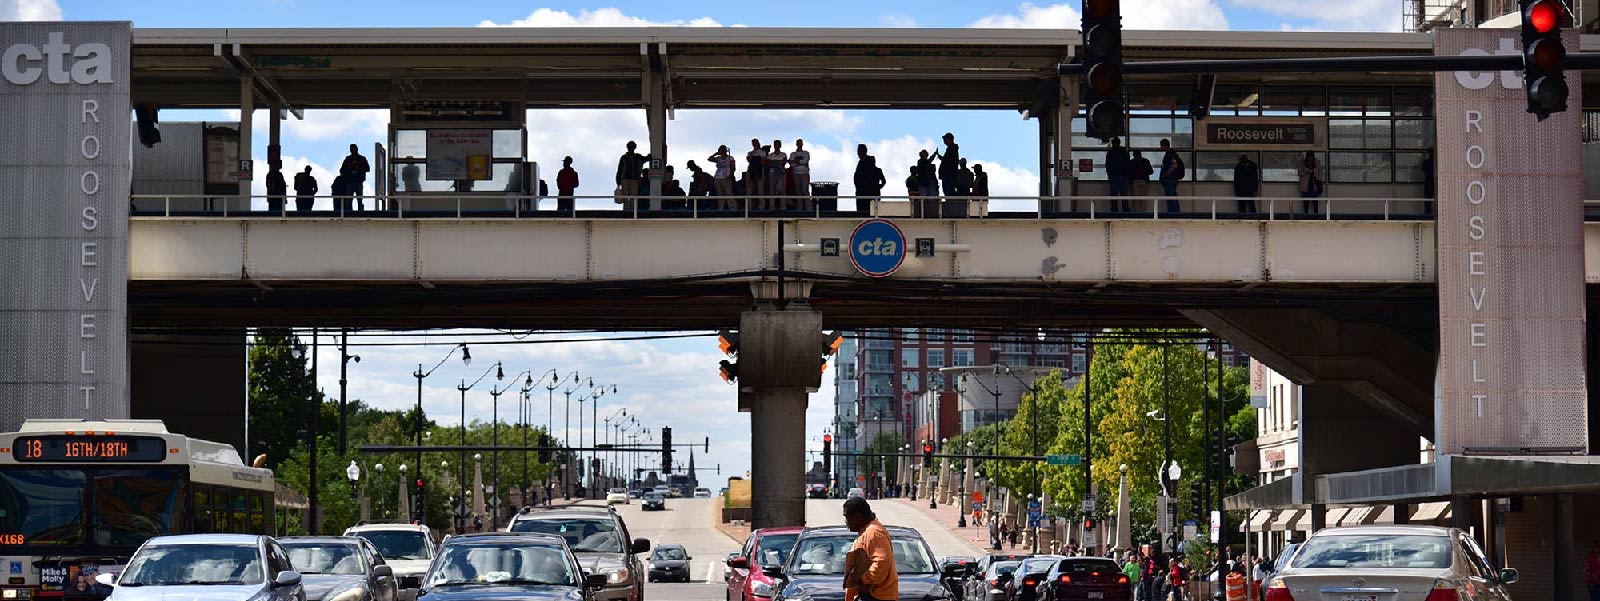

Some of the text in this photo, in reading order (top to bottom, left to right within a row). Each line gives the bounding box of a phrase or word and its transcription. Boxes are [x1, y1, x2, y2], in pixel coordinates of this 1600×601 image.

[2, 31, 113, 85] cta
[1454, 38, 1523, 89] ct
[1217, 128, 1284, 141] Roosevelt
[241, 161, 250, 171] R
[1062, 161, 1071, 171] R
[80, 99, 100, 411] ROOSEVELT
[859, 238, 898, 257] cta
[1465, 110, 1487, 418] ROOSEVELT
[25, 440, 128, 458] 18 16TH/18TH
[43, 568, 61, 576] Mike
[43, 576, 65, 584] Molly
